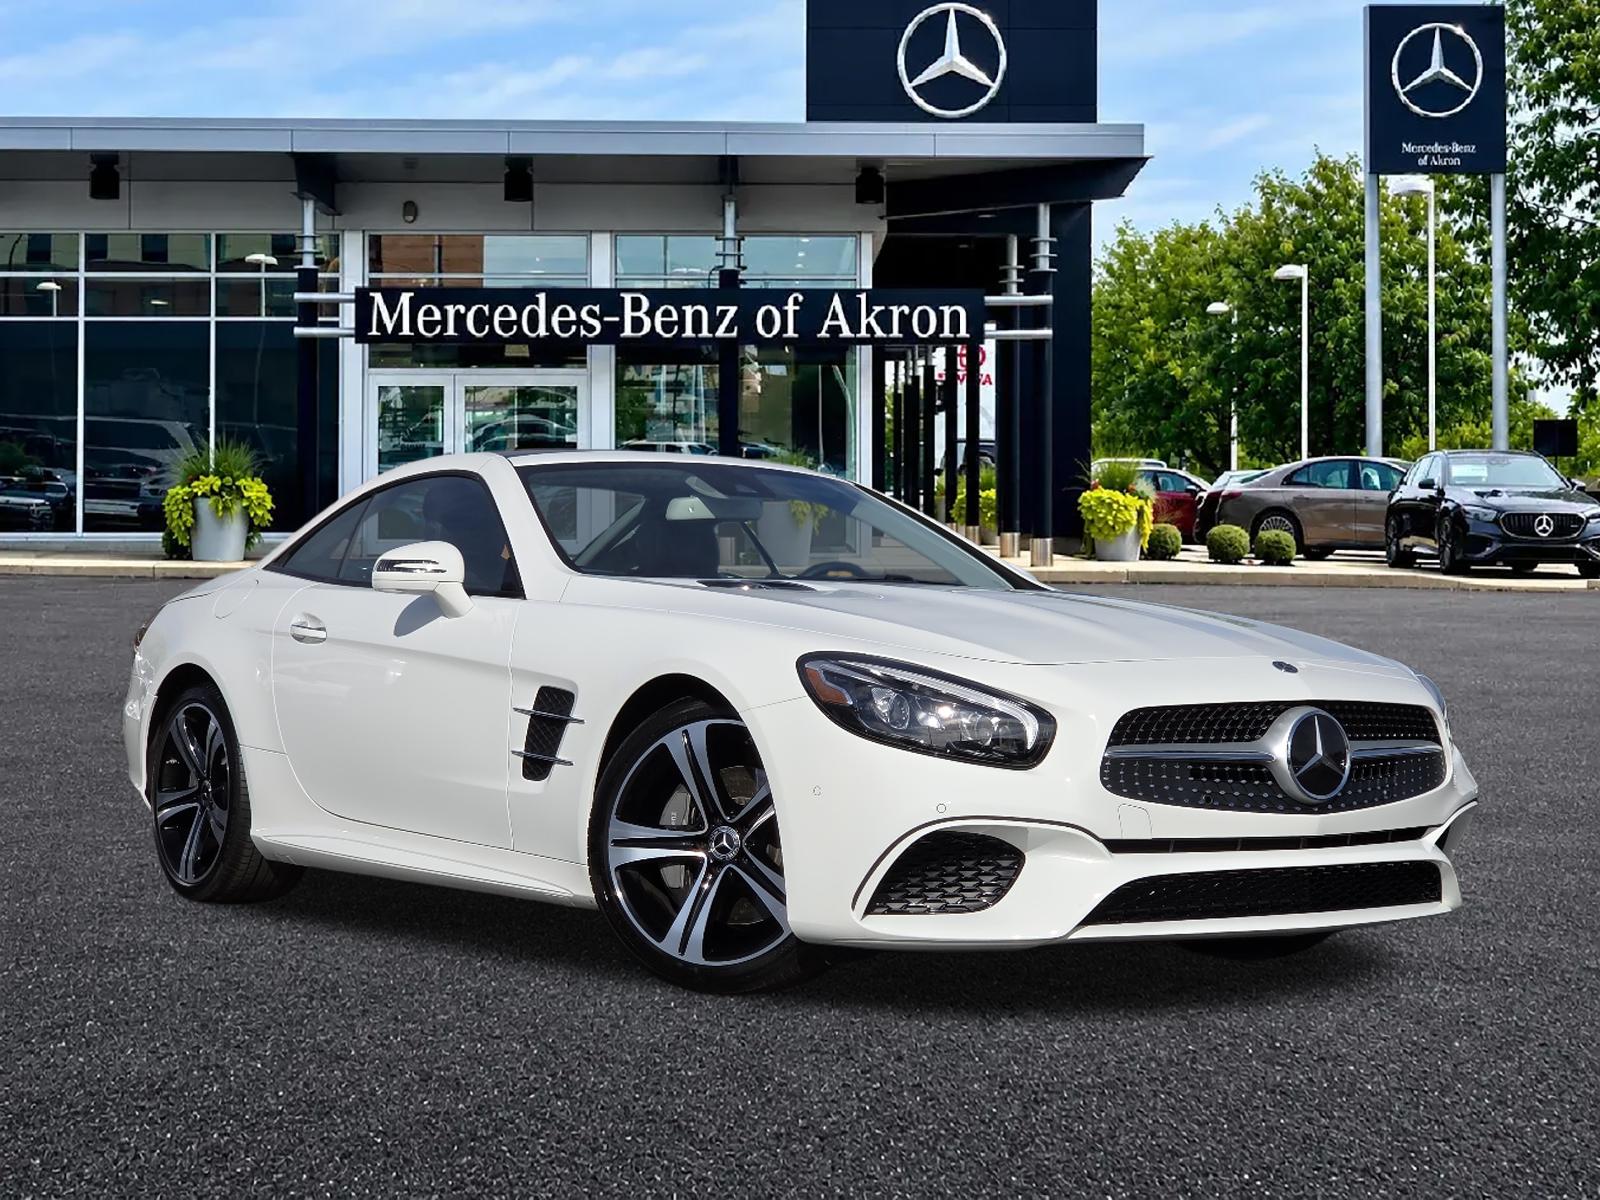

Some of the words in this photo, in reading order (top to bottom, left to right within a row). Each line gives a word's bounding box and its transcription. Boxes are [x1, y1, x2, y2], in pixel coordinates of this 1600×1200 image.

[1401, 141, 1476, 154] Mercedes-Benz
[1418, 154, 1428, 166] of
[1430, 154, 1461, 166] Akron
[367, 291, 738, 339] Mercedes-Benz
[755, 291, 804, 339] of
[816, 291, 971, 339] Akron
